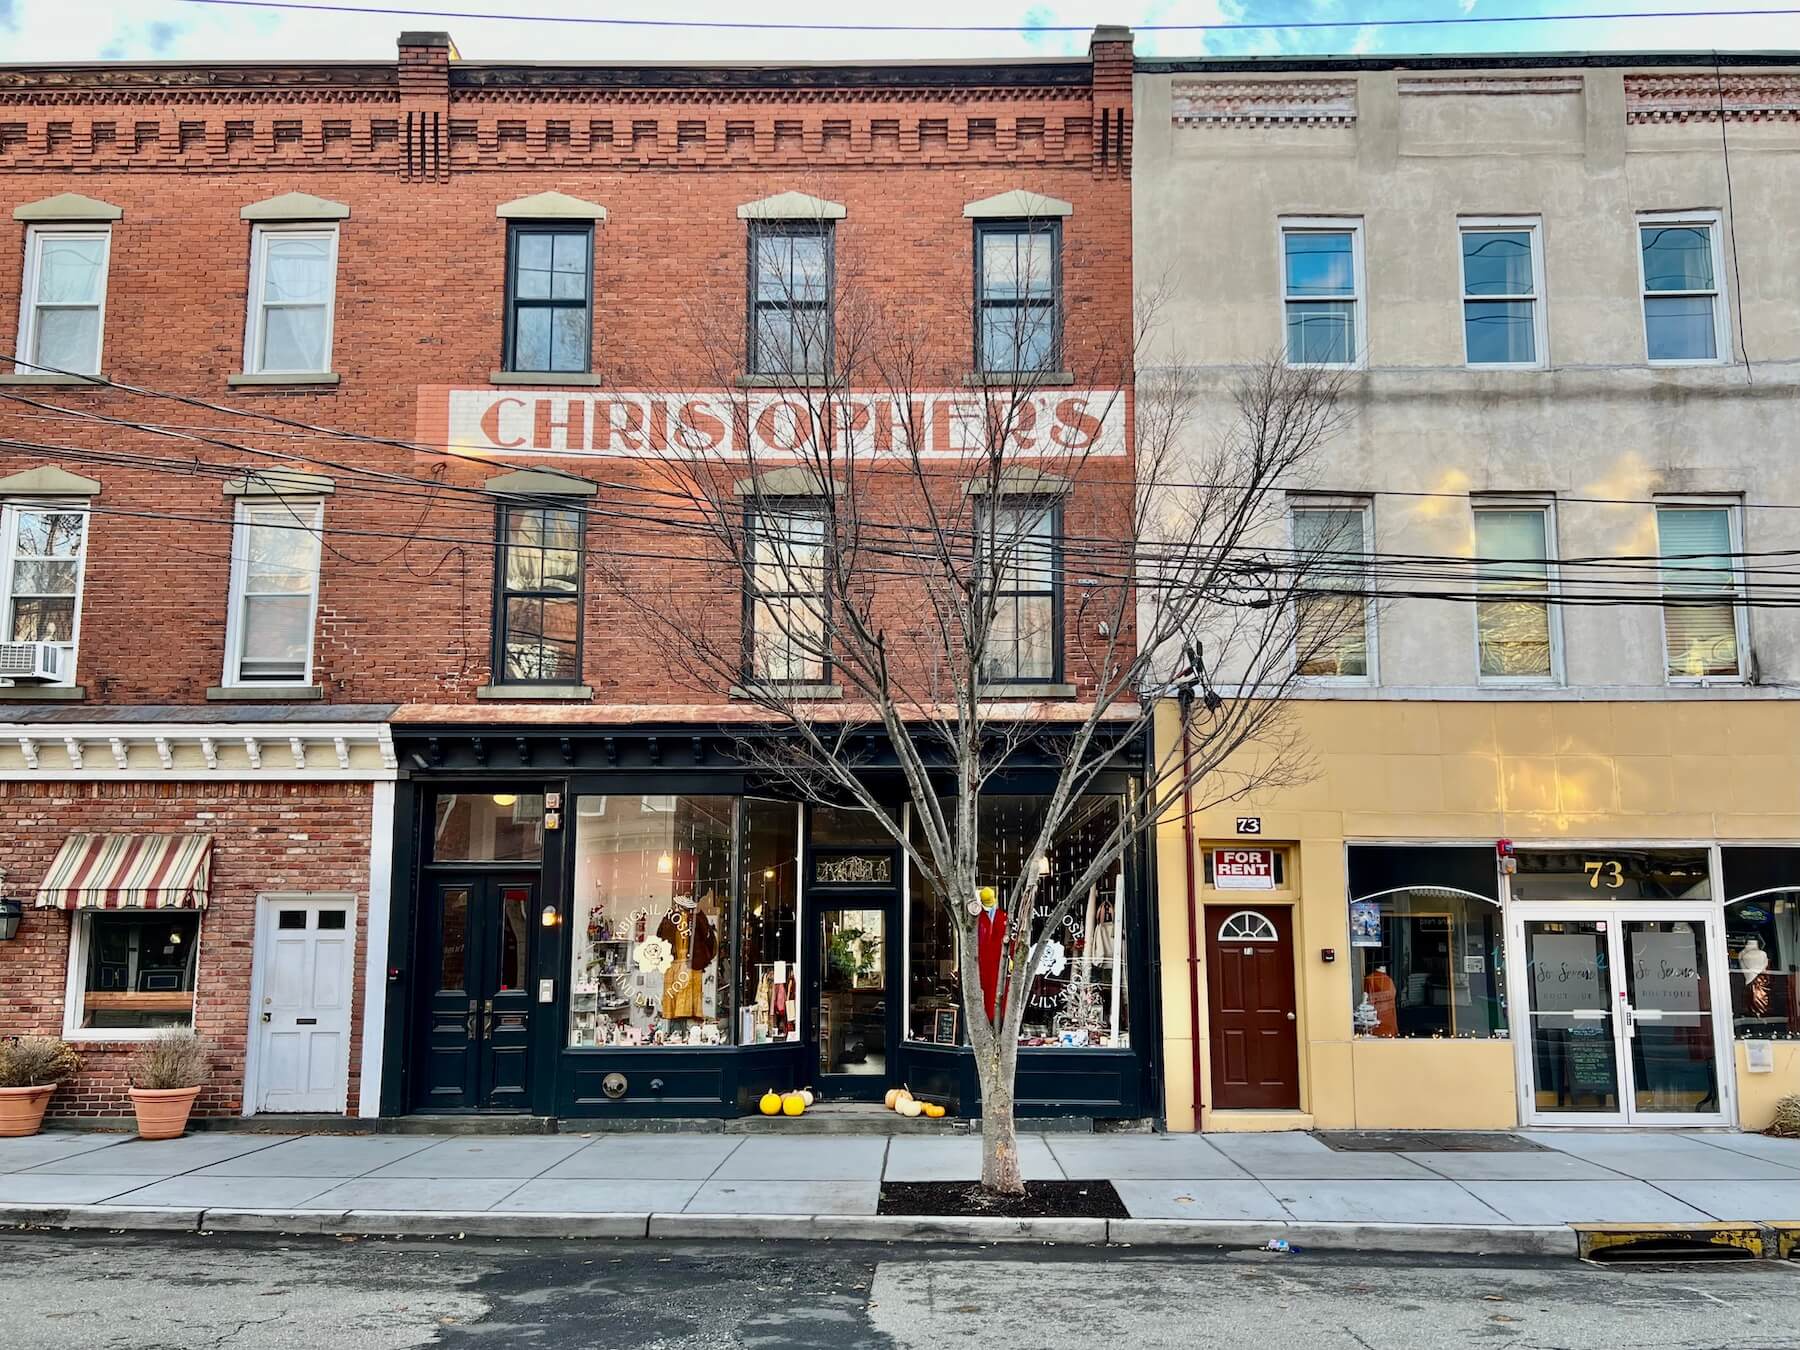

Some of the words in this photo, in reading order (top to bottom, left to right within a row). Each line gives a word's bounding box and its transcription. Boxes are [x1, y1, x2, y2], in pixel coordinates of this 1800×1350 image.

[480, 397, 1103, 450] CHRISTOPHER'S
[1237, 818, 1259, 833] 73
[1217, 863, 1269, 875] RENT
[1223, 852, 1262, 863] FOR
[1584, 861, 1624, 888] 73
[615, 903, 661, 940] ABIGAIL
[663, 907, 691, 939] ROSE
[1062, 914, 1085, 942] OSE
[666, 971, 690, 1000] TOO
[1030, 994, 1058, 1009] LILY
